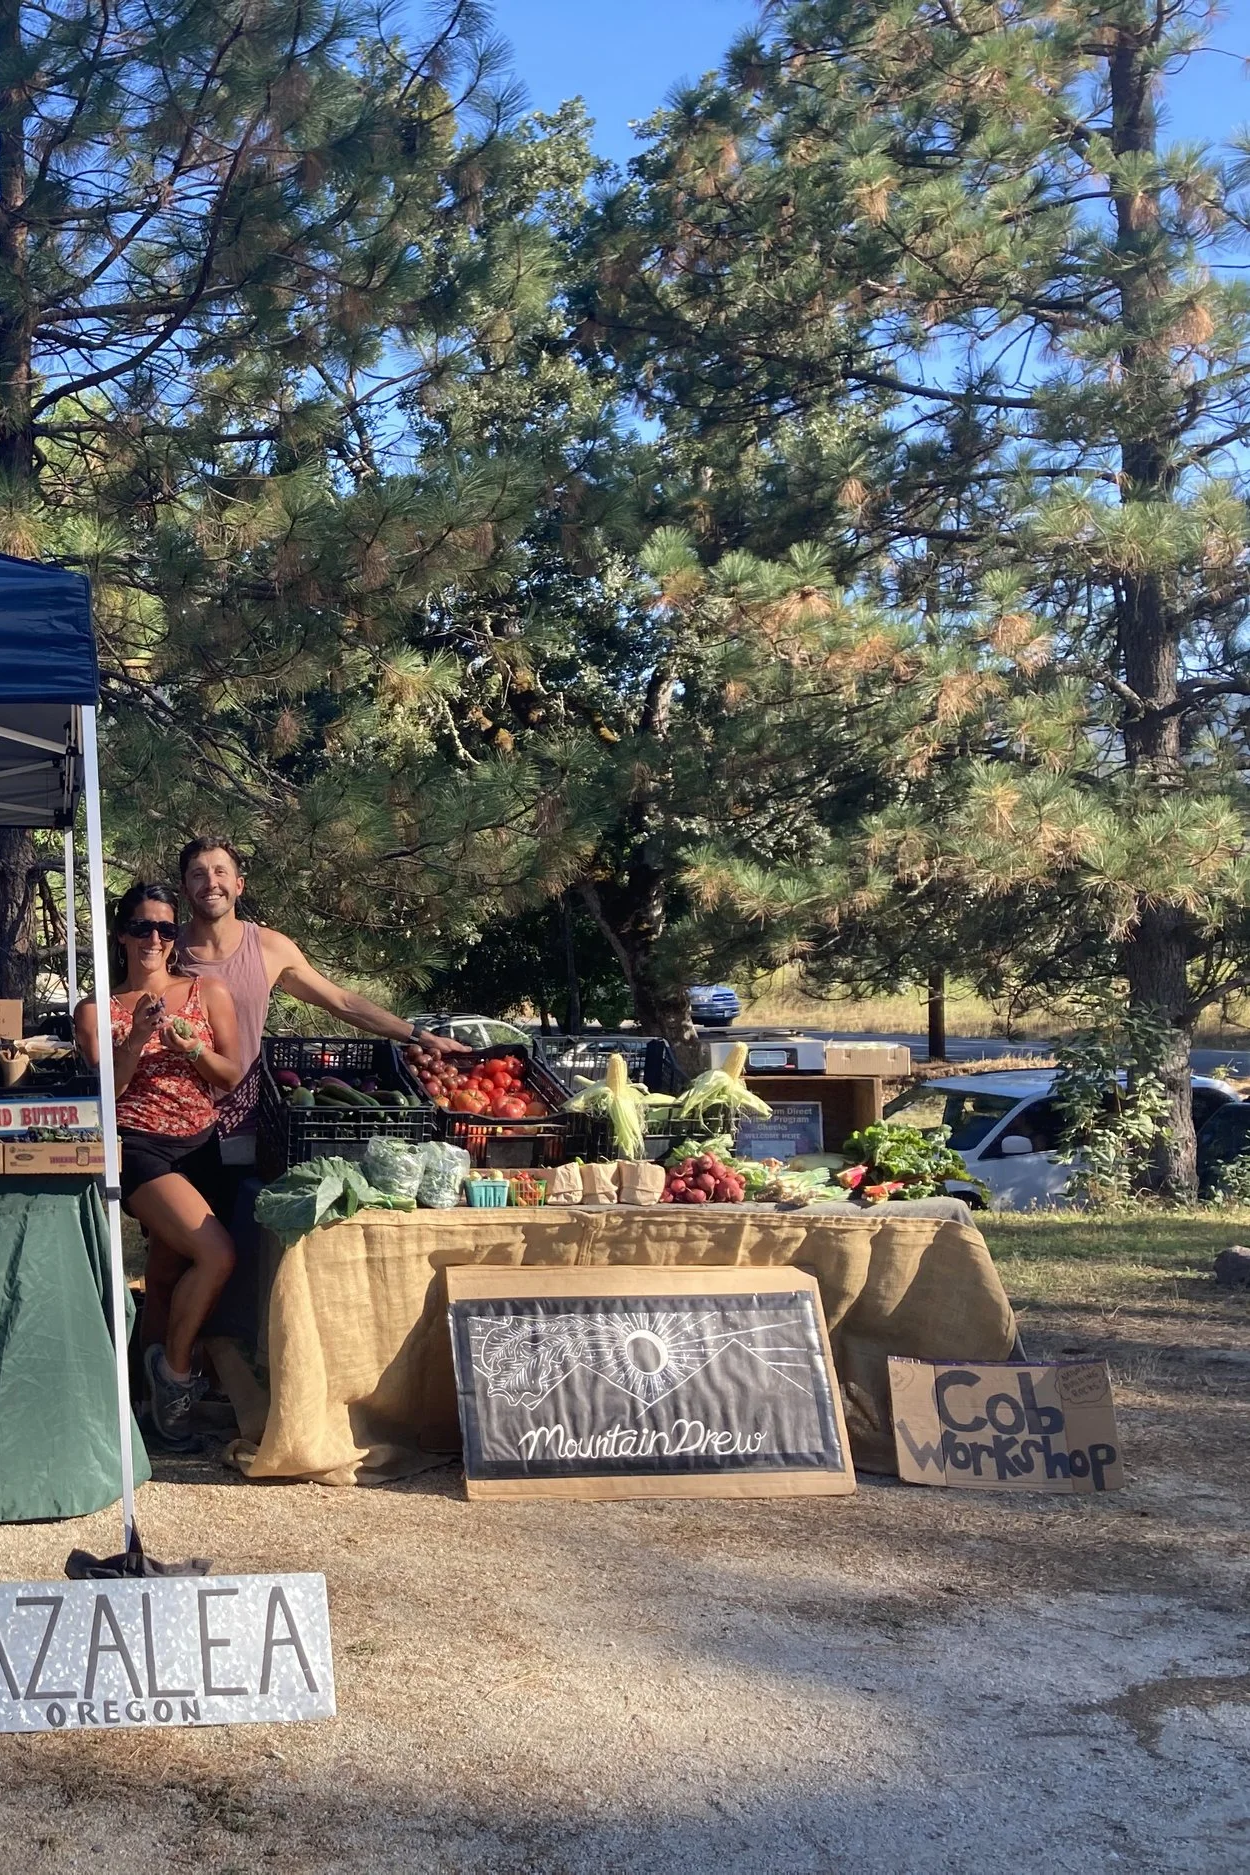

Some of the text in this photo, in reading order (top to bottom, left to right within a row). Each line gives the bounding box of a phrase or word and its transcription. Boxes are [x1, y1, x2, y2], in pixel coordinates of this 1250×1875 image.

[20, 1106, 79, 1126] BUTTER
[787, 1107, 812, 1115] Direct
[757, 1123, 788, 1131] Checks
[773, 1116, 810, 1125] Program
[932, 1369, 1065, 1435] Cob
[46, 1699, 202, 1727] OREGON
